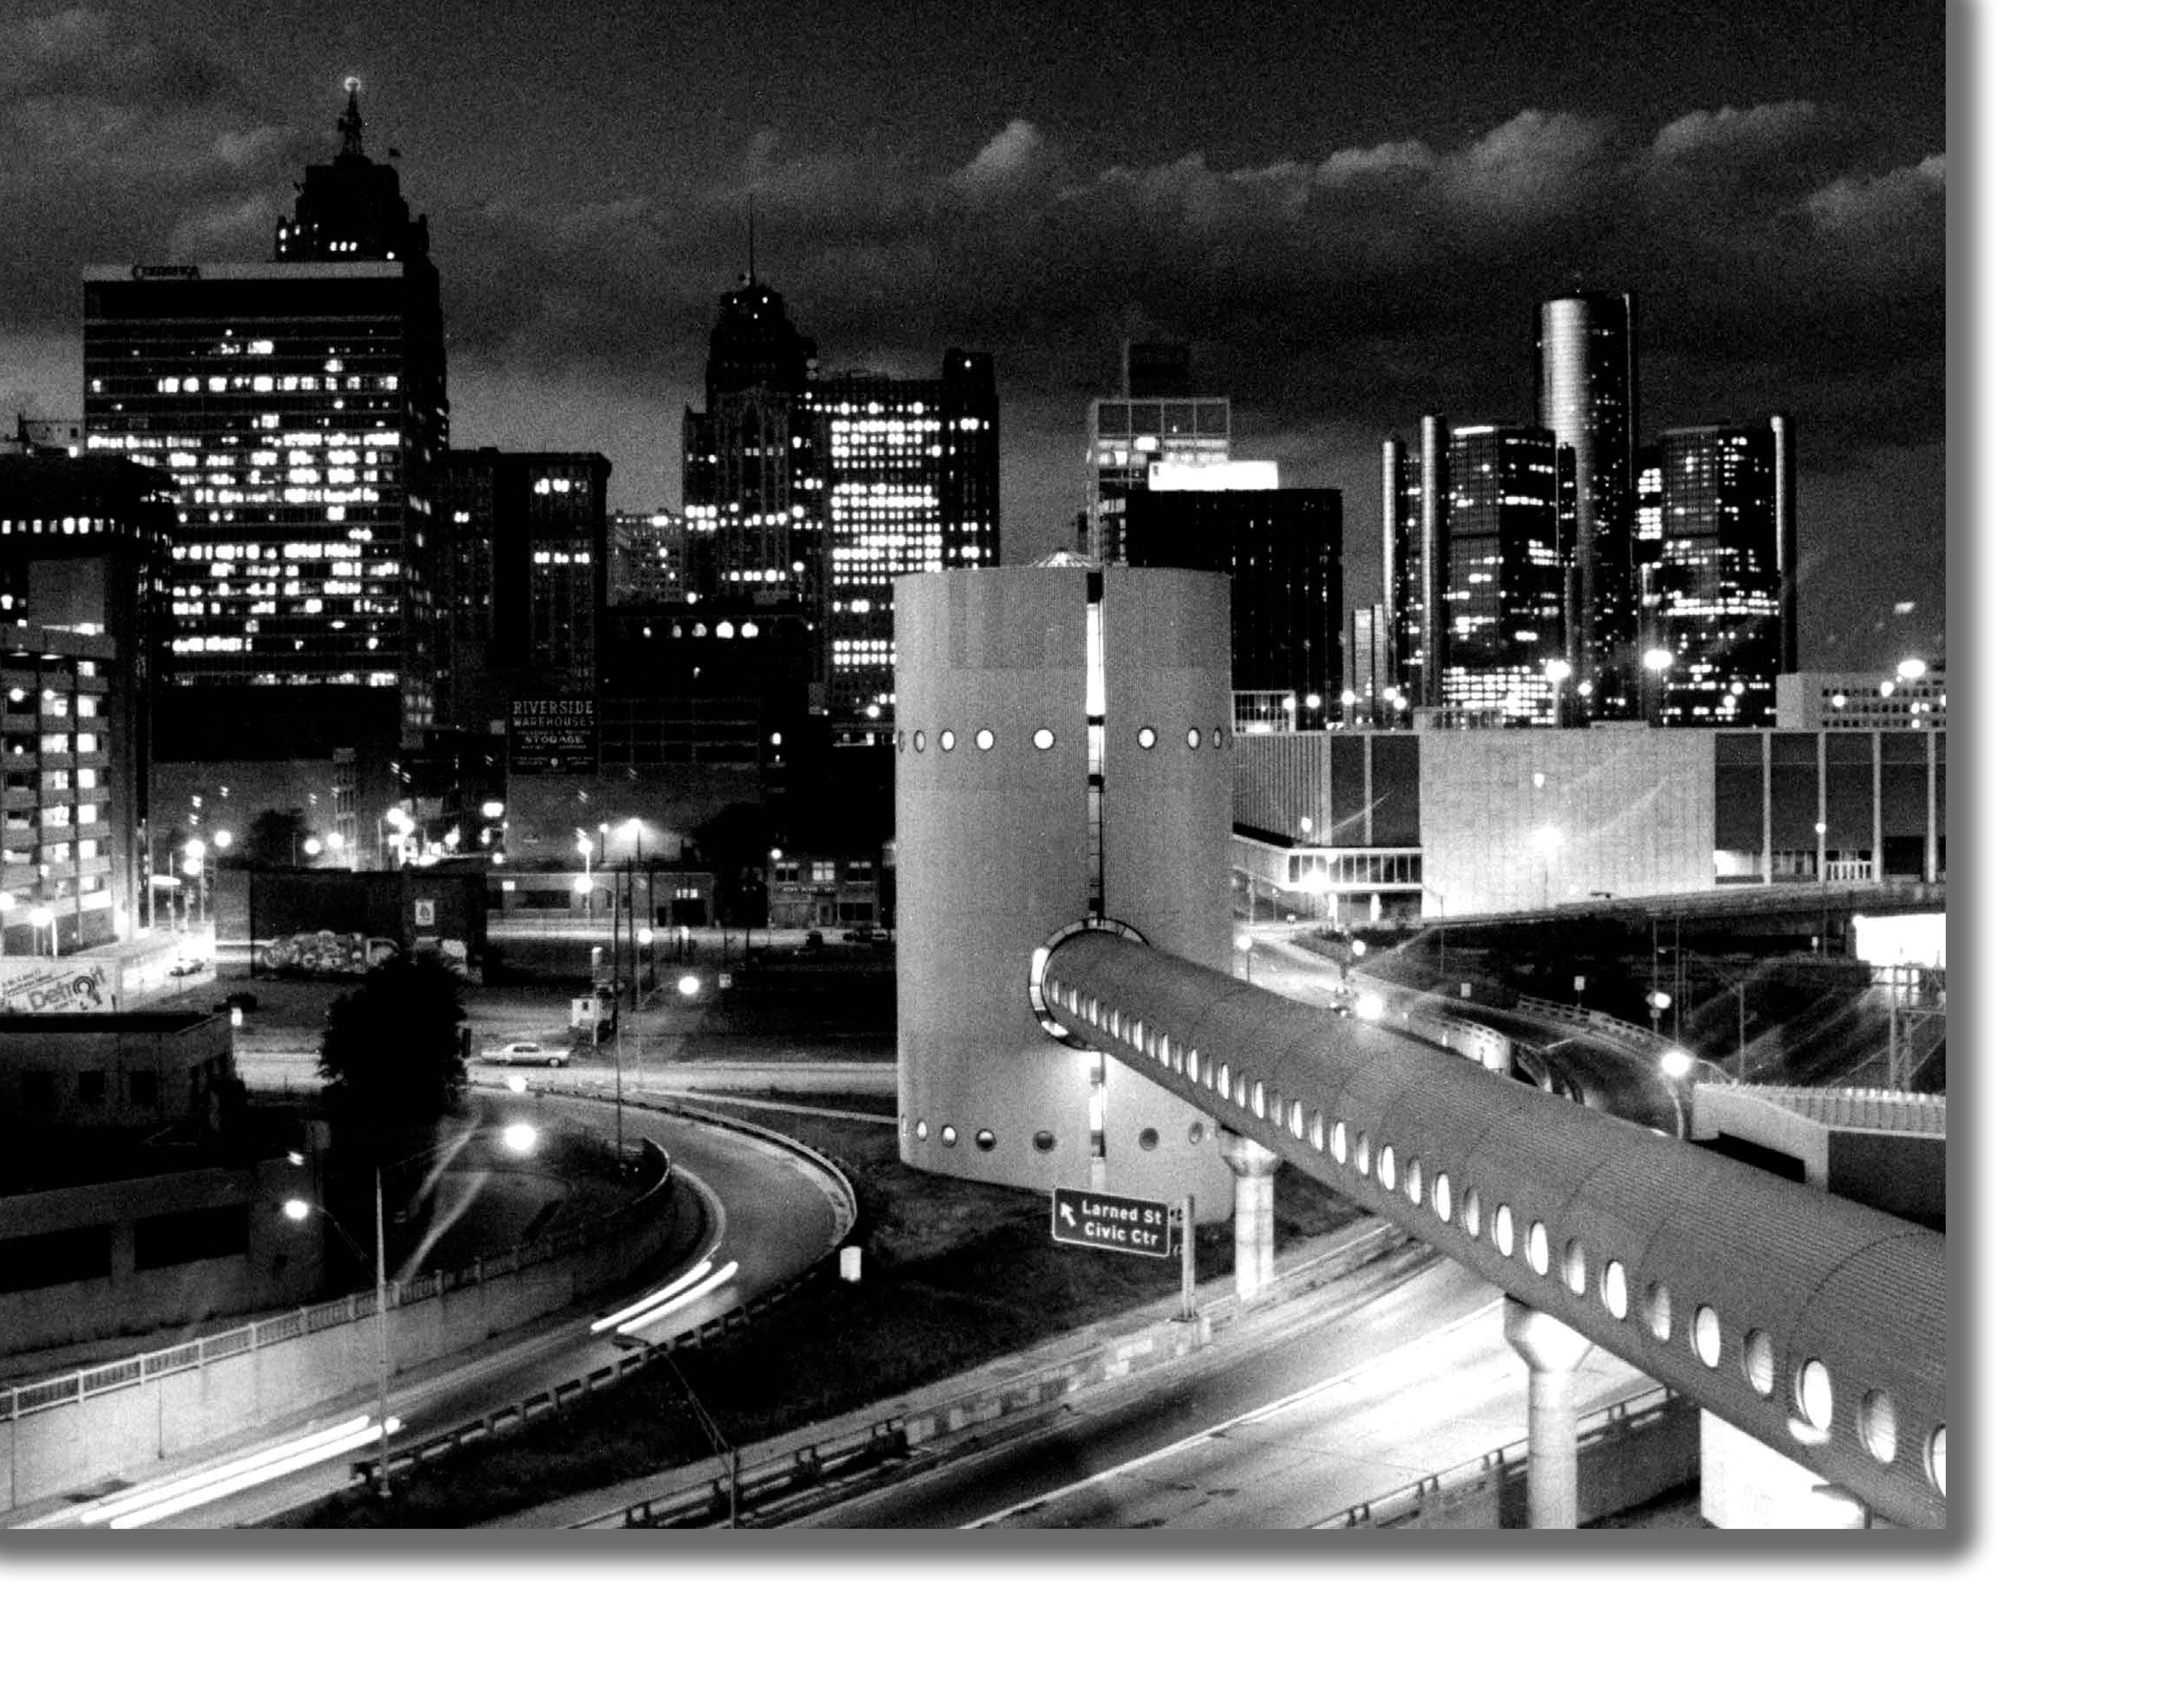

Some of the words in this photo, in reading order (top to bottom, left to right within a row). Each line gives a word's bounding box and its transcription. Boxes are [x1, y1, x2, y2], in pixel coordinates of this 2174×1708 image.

[512, 700, 593, 715] RIVERSIDE
[513, 716, 594, 727] WAREHOUSES
[524, 735, 584, 744] STORAGE
[1082, 1200, 1138, 1221] Larned
[1143, 1210, 1162, 1225] St
[1085, 1221, 1126, 1241] Civic
[1131, 1229, 1158, 1245] Ctr
